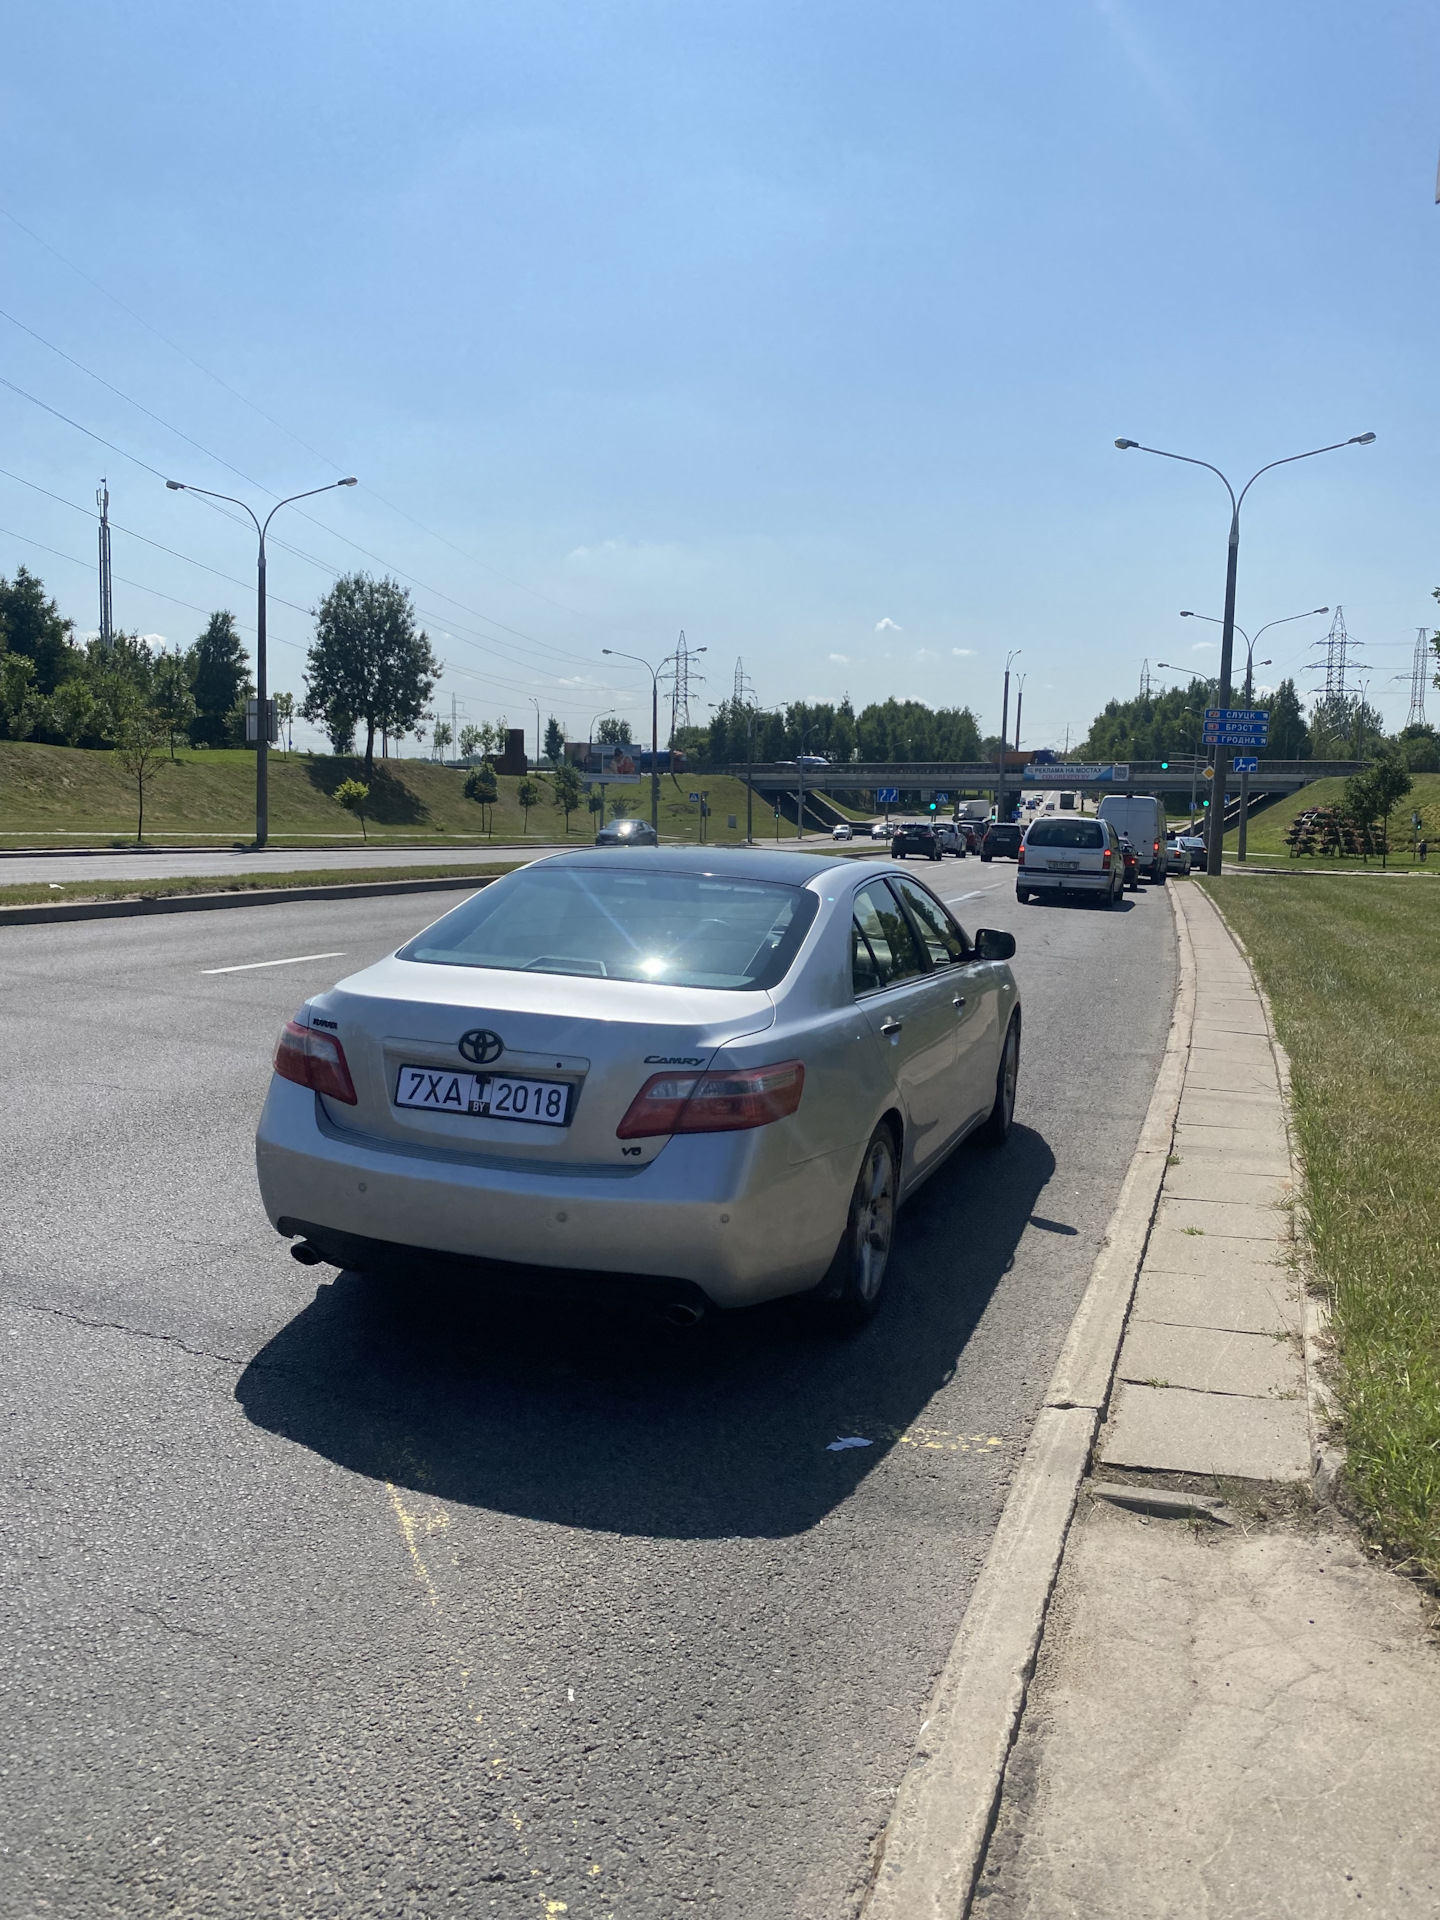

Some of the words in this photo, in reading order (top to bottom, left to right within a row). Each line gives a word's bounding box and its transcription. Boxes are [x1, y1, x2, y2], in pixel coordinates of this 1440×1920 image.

[1226, 711, 1256, 720] СЛУЦК
[1225, 723, 1254, 732] БРЭСТ
[1221, 736, 1256, 745] ГРОДНА
[312, 1018, 338, 1030] TOYOTA
[495, 1083, 562, 1118] 2018
[472, 1101, 485, 1113] BY
[621, 1147, 642, 1156] V6
